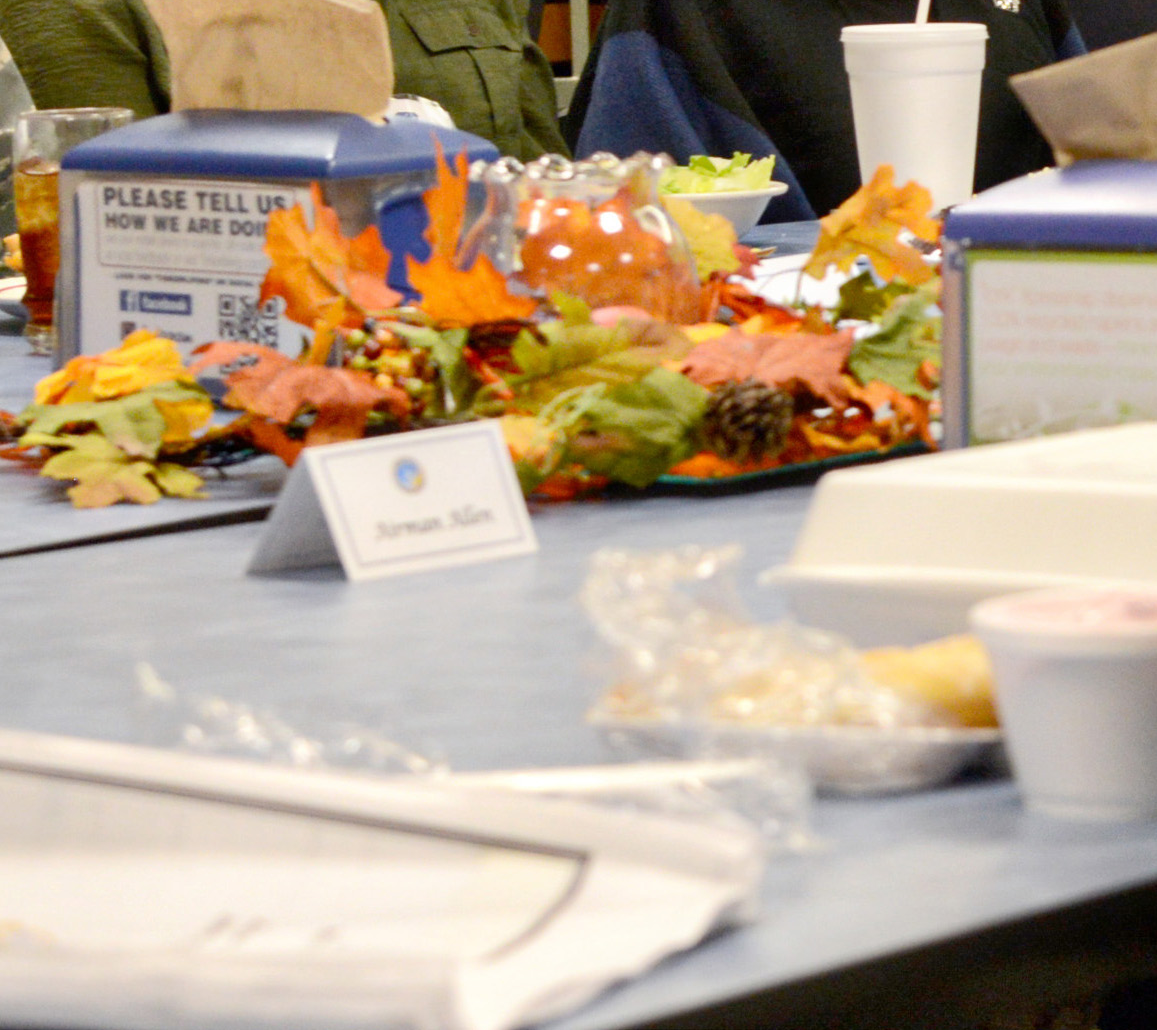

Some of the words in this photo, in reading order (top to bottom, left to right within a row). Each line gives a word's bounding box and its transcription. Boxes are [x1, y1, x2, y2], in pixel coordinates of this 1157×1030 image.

[103, 186, 188, 210] PLEASE
[196, 191, 249, 214] TELL
[256, 194, 286, 215] US
[105, 213, 147, 231] HOW
[153, 215, 180, 233] WE
[188, 218, 222, 236] ARE
